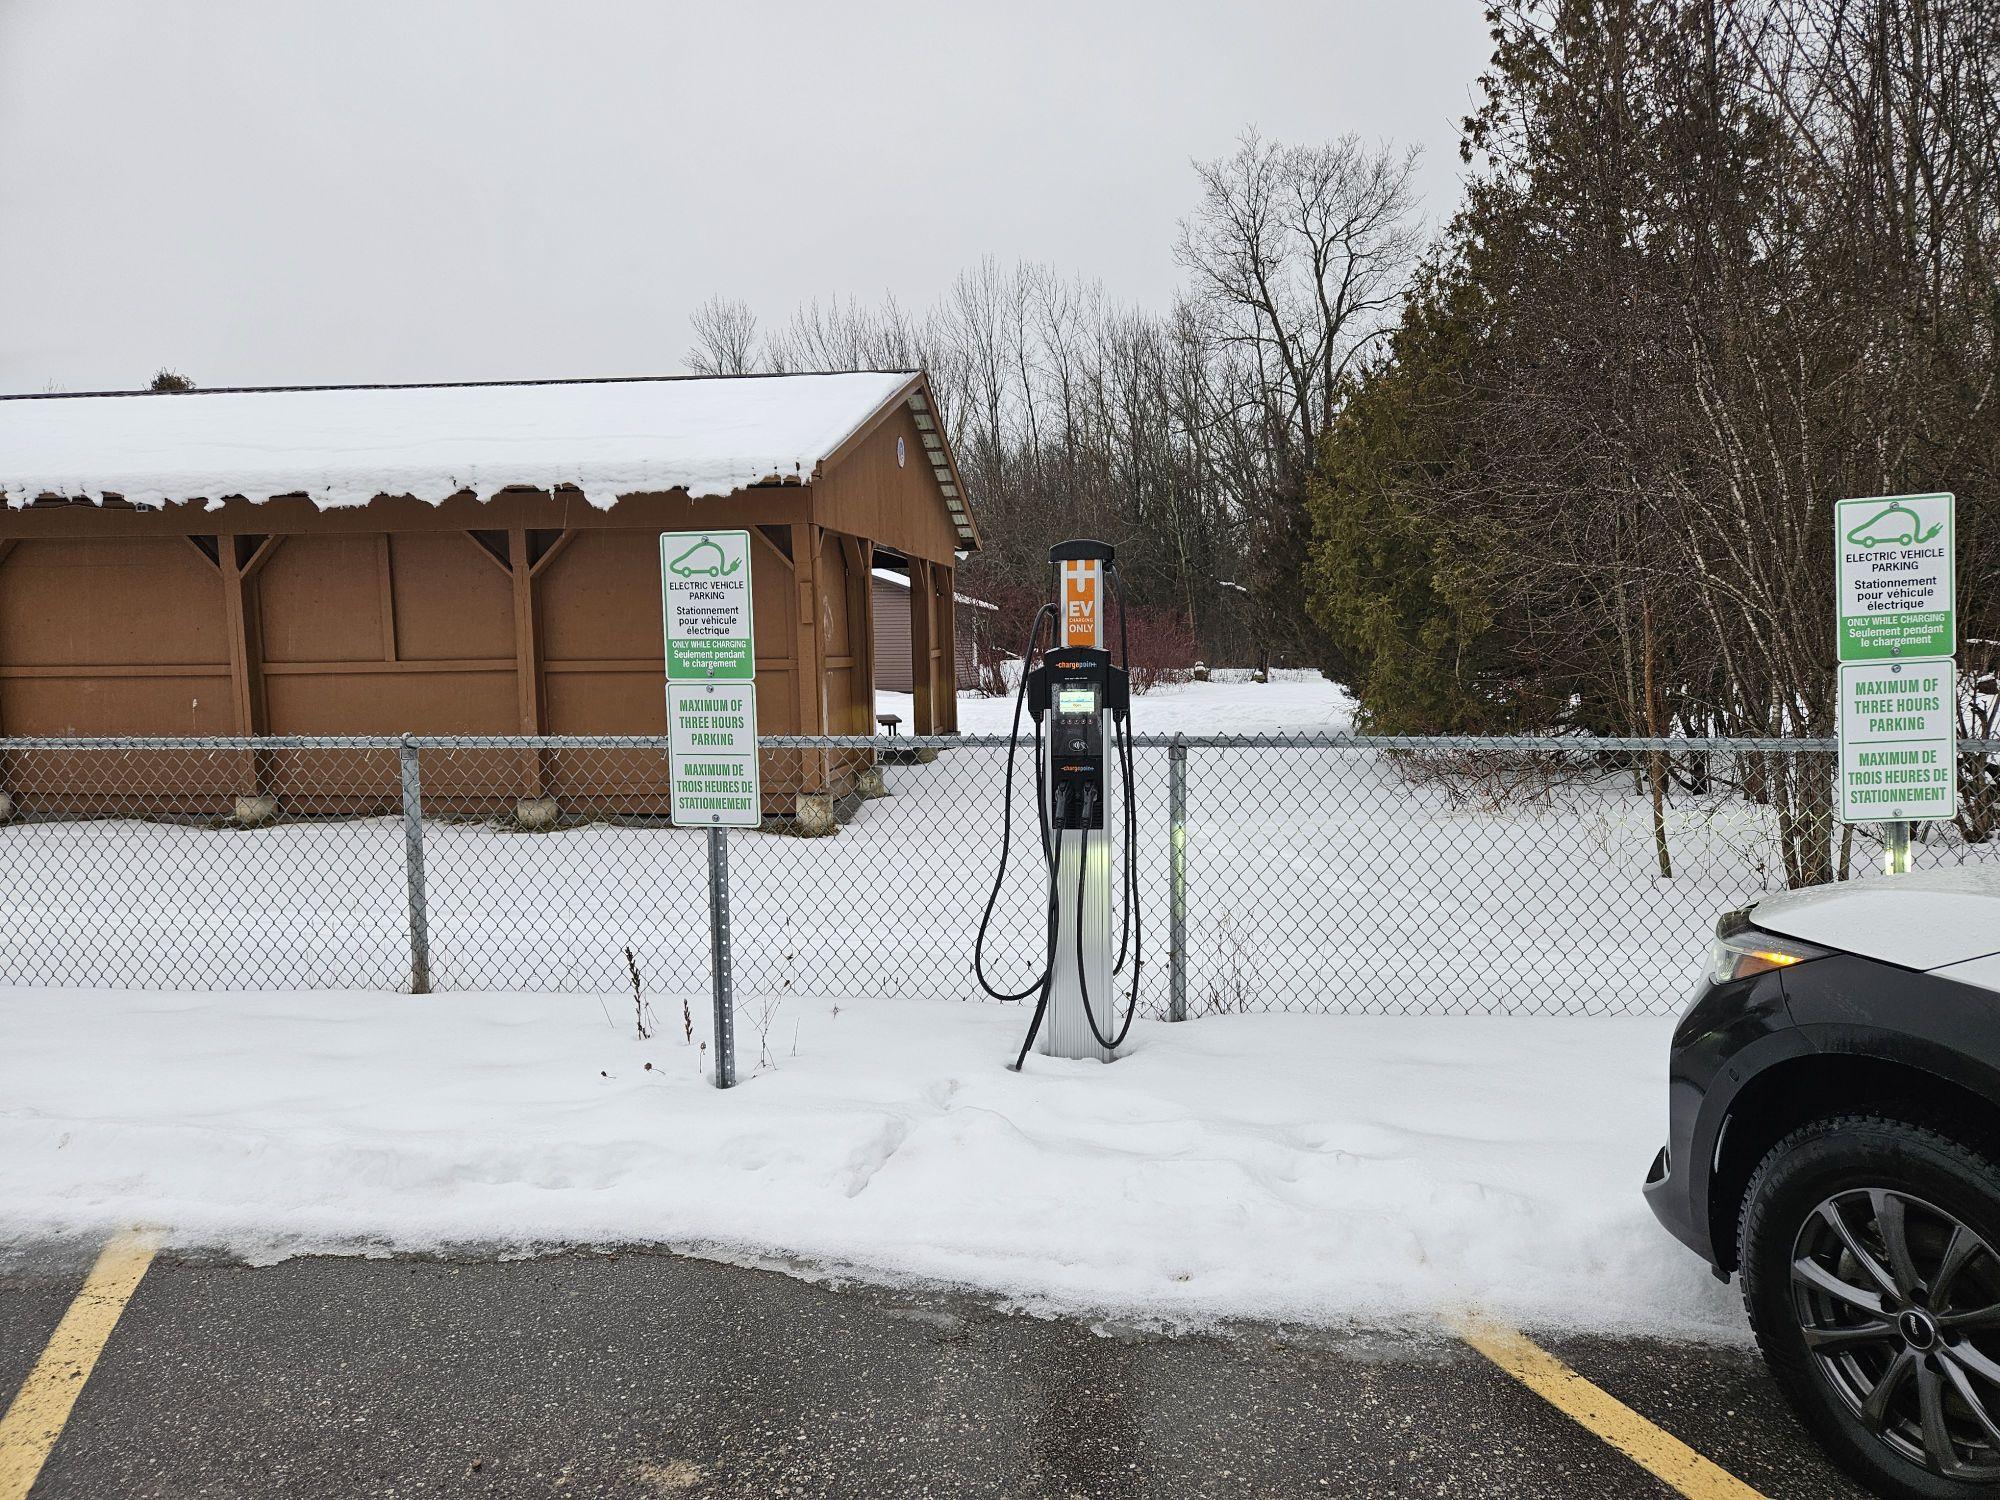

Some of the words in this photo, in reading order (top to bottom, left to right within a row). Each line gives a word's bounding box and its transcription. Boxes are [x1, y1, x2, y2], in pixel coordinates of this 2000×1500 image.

[1846, 551, 1897, 563] ELECTRIC
[1900, 548, 1944, 560] VEHICLE
[1872, 561, 1919, 572] PARKING
[669, 582, 708, 590] ELECTRIC
[710, 581, 744, 590] VEHICLE
[1854, 576, 1937, 590] Stationnement
[689, 592, 725, 600] PARKING
[1858, 591, 1884, 602] pour
[1887, 587, 1934, 599] véhicule
[676, 606, 739, 615] Stationnement
[1069, 601, 1093, 617] EV
[1867, 600, 1924, 611] électrique
[679, 617, 698, 626] pour
[701, 616, 737, 625] véhicule
[1848, 618, 1869, 626] ONLY
[1872, 616, 1898, 625] WHILE
[1900, 613, 1945, 624] CHARGING
[687, 626, 729, 635] électrique
[1069, 624, 1093, 633] ONLY
[1849, 627, 1901, 638] Seulement
[1904, 624, 1944, 635] pendant
[672, 640, 689, 648] ONLY
[691, 640, 710, 648] WHILE
[712, 640, 746, 648] CHARGING
[1861, 637, 1869, 647] le
[1873, 634, 1932, 647] chargement
[674, 650, 713, 659] Seulement
[715, 649, 745, 659] pendant
[683, 659, 690, 667] le
[692, 659, 736, 669] chargement
[1856, 679, 1919, 695] MAXIMUM
[1923, 678, 1939, 692] OF
[679, 700, 728, 712] MAXIMUM
[731, 700, 742, 711] OF
[1854, 699, 1893, 714] THREE
[1897, 697, 1940, 712] HOURS
[679, 716, 709, 729] THREE
[712, 716, 744, 729] HOURS
[1870, 716, 1925, 732] PARKING
[691, 733, 733, 746] PARKING
[1859, 751, 1919, 766] MAXIMUM
[1922, 750, 1937, 764] DE
[684, 764, 730, 776] MAXIMUM
[732, 764, 744, 776] DE
[1848, 771, 1882, 785] TROIS
[1885, 769, 1930, 784] HEURES
[1934, 768, 1948, 782] DE
[677, 781, 702, 793] TROIS
[704, 781, 739, 793] HEURES
[742, 781, 753, 793] DE
[1850, 787, 1946, 804] STATIONNEMENT
[679, 797, 752, 810] STATIONNEMENT
